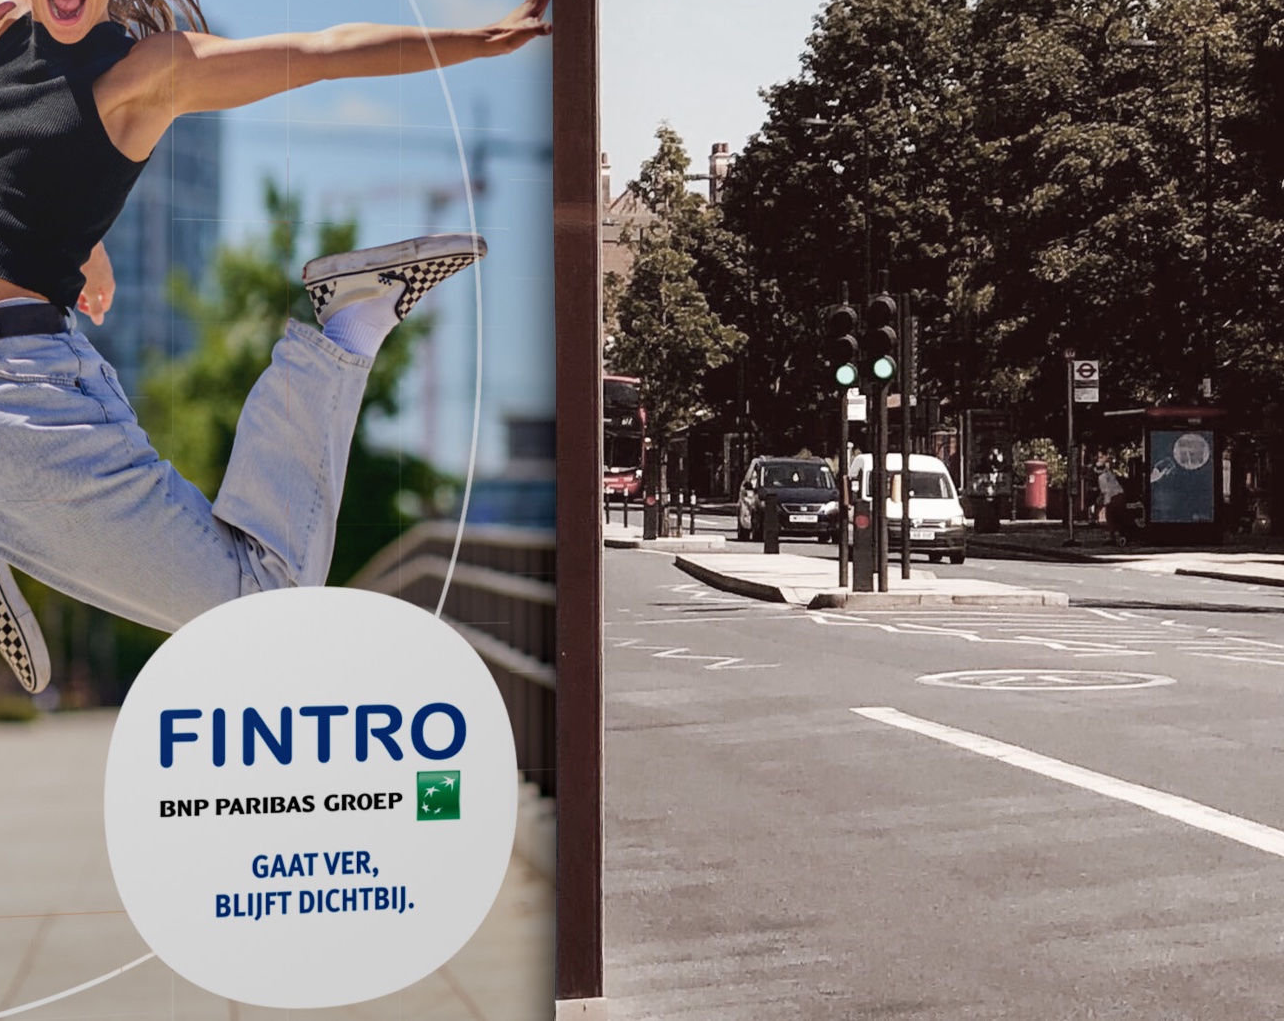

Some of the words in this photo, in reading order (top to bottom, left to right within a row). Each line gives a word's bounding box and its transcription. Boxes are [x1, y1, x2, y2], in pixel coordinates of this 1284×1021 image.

[160, 702, 466, 768] FINTRO
[160, 799, 209, 817] BNP
[216, 795, 315, 815] PARIBAS
[324, 792, 403, 811] GROEP
[252, 853, 318, 878] GAAT
[324, 850, 379, 877] VER,
[216, 891, 292, 921] BLIJFT
[299, 886, 415, 914] DICHTBIJ.
